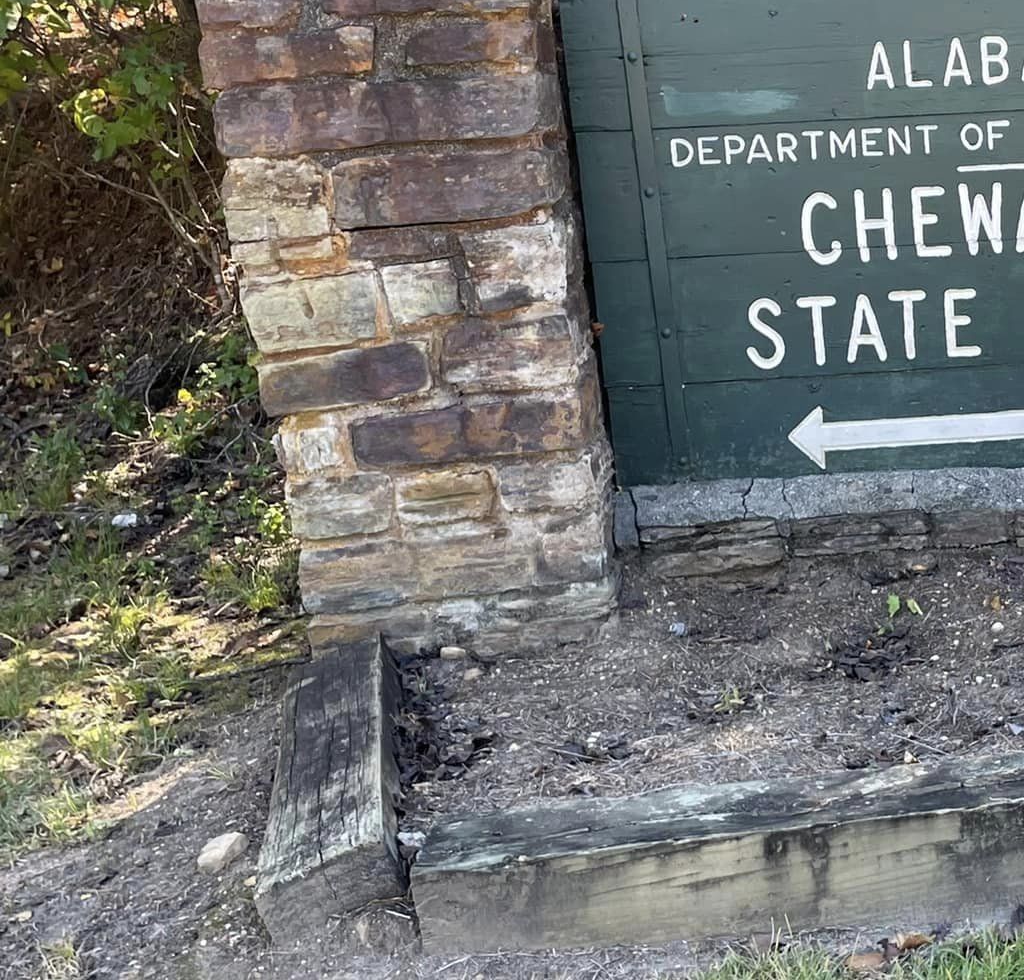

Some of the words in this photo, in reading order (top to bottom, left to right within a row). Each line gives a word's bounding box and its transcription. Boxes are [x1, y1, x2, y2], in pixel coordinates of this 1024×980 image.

[669, 124, 939, 168] DEPARTMENT
[959, 119, 1011, 151] OF
[746, 288, 982, 370] STATE
